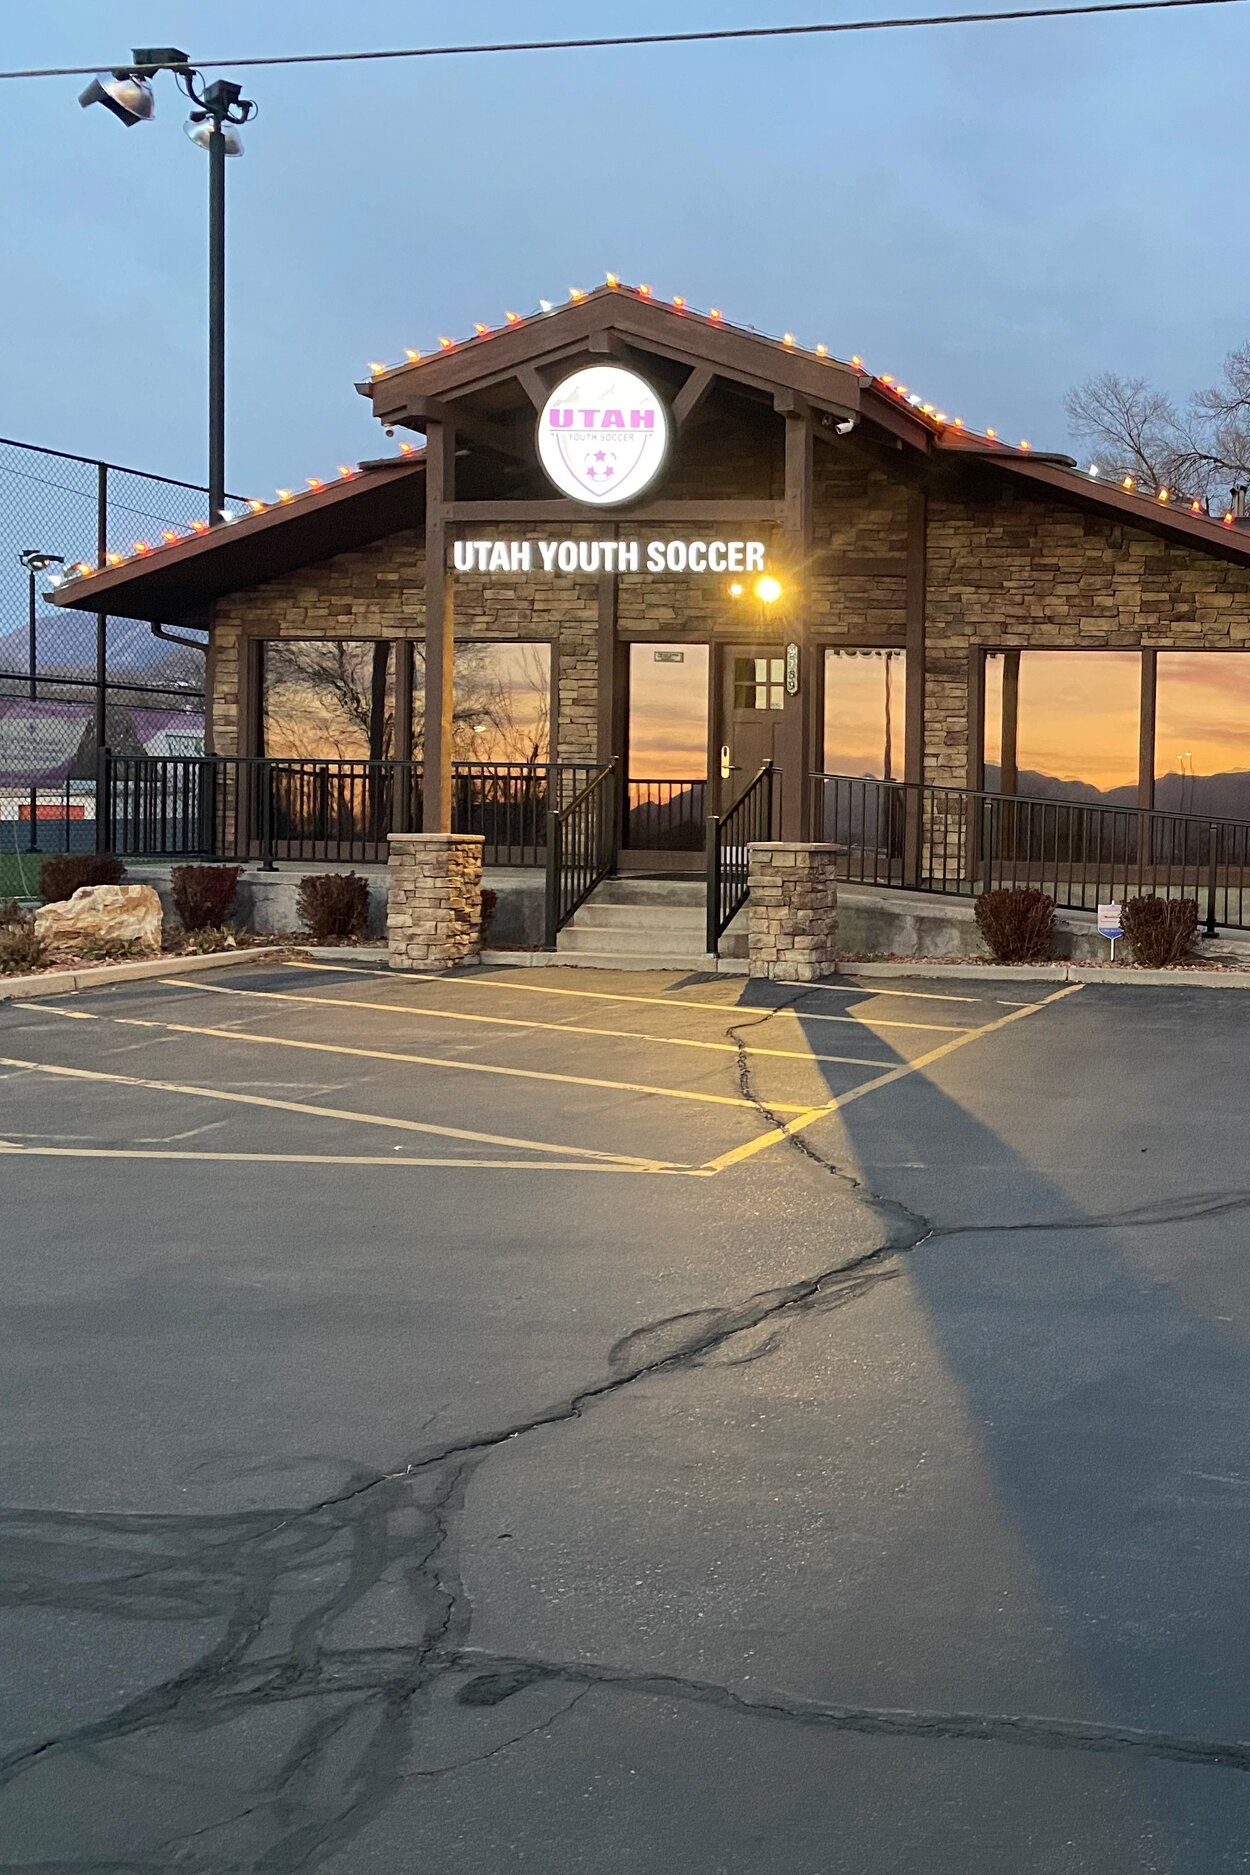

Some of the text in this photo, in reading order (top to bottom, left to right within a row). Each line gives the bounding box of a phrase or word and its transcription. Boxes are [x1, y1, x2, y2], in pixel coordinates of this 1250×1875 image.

[549, 409, 655, 428] UTAH
[568, 433, 634, 442] YOUTH SOCCER
[454, 541, 765, 572] UTAH YOUTH SOCCER
